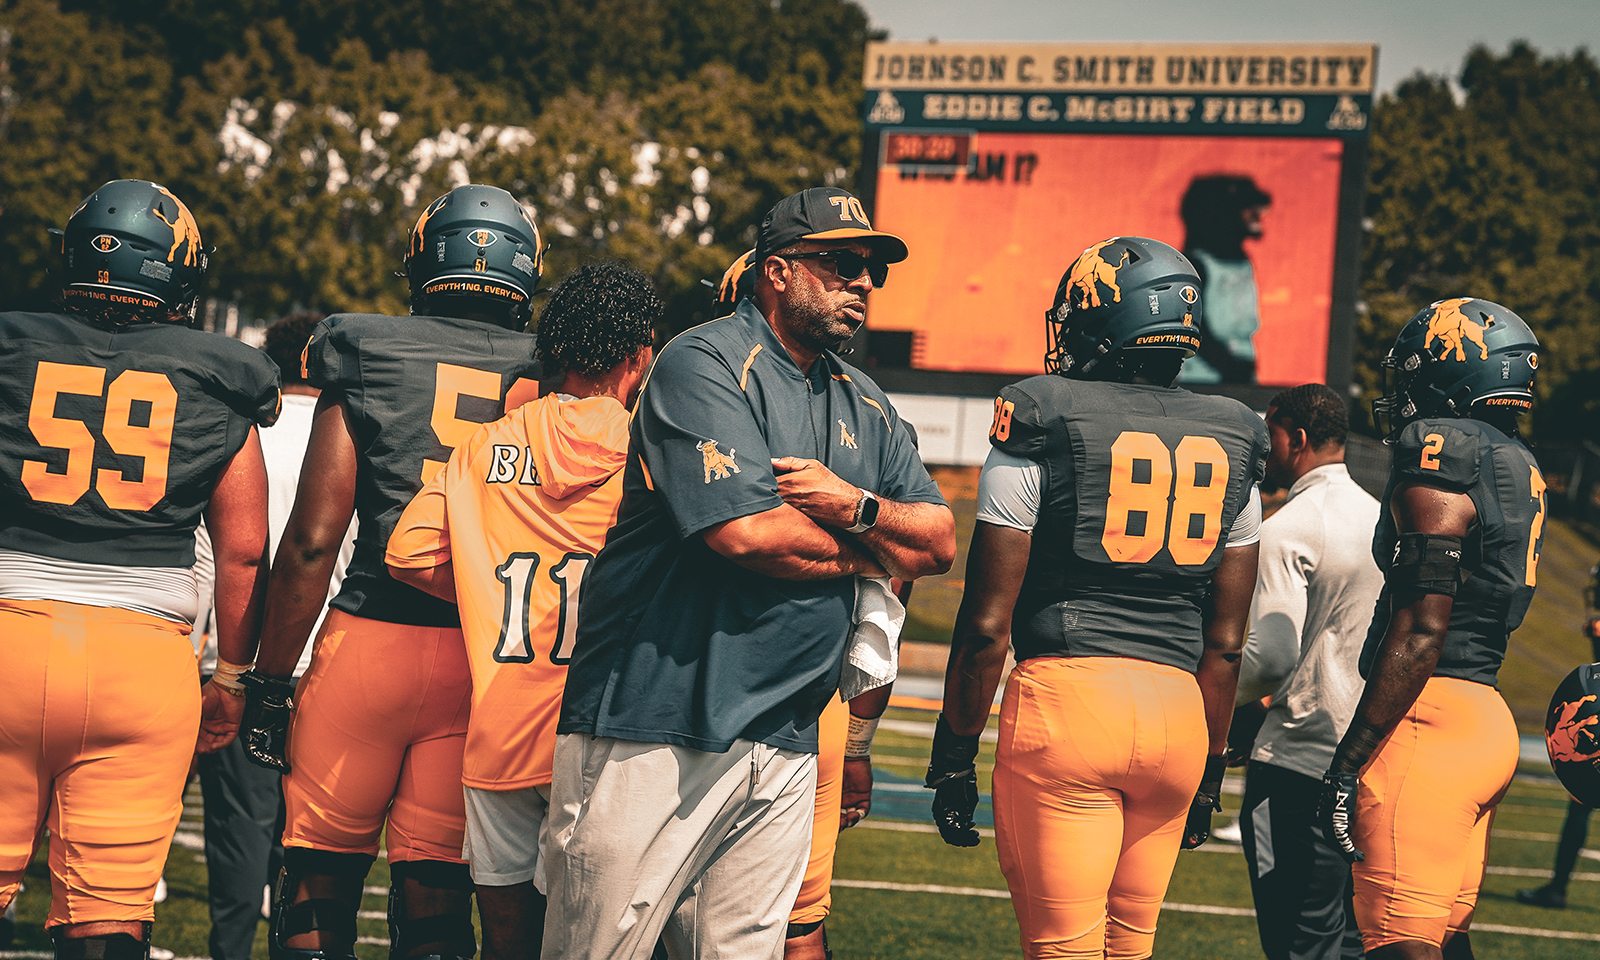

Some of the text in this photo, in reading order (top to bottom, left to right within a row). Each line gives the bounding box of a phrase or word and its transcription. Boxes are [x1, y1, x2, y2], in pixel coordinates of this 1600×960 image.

[874, 54, 1366, 86] JOHNSON C. SMITH UNIVERSITY
[922, 94, 1305, 125] EDDIE C. McGIRT FIELD
[829, 196, 872, 229] 70
[100, 237, 111, 245] PN
[477, 231, 488, 240] PN
[98, 270, 109, 284] 59
[475, 258, 486, 273] 51
[110, 294, 140, 305] EVERY
[142, 299, 159, 308] DAY
[484, 285, 511, 297] EVERY
[511, 292, 523, 302] DAY
[21, 360, 179, 512] 59
[1420, 433, 1445, 471] 2
[1101, 430, 1230, 566] 88
[493, 552, 598, 665] 11
